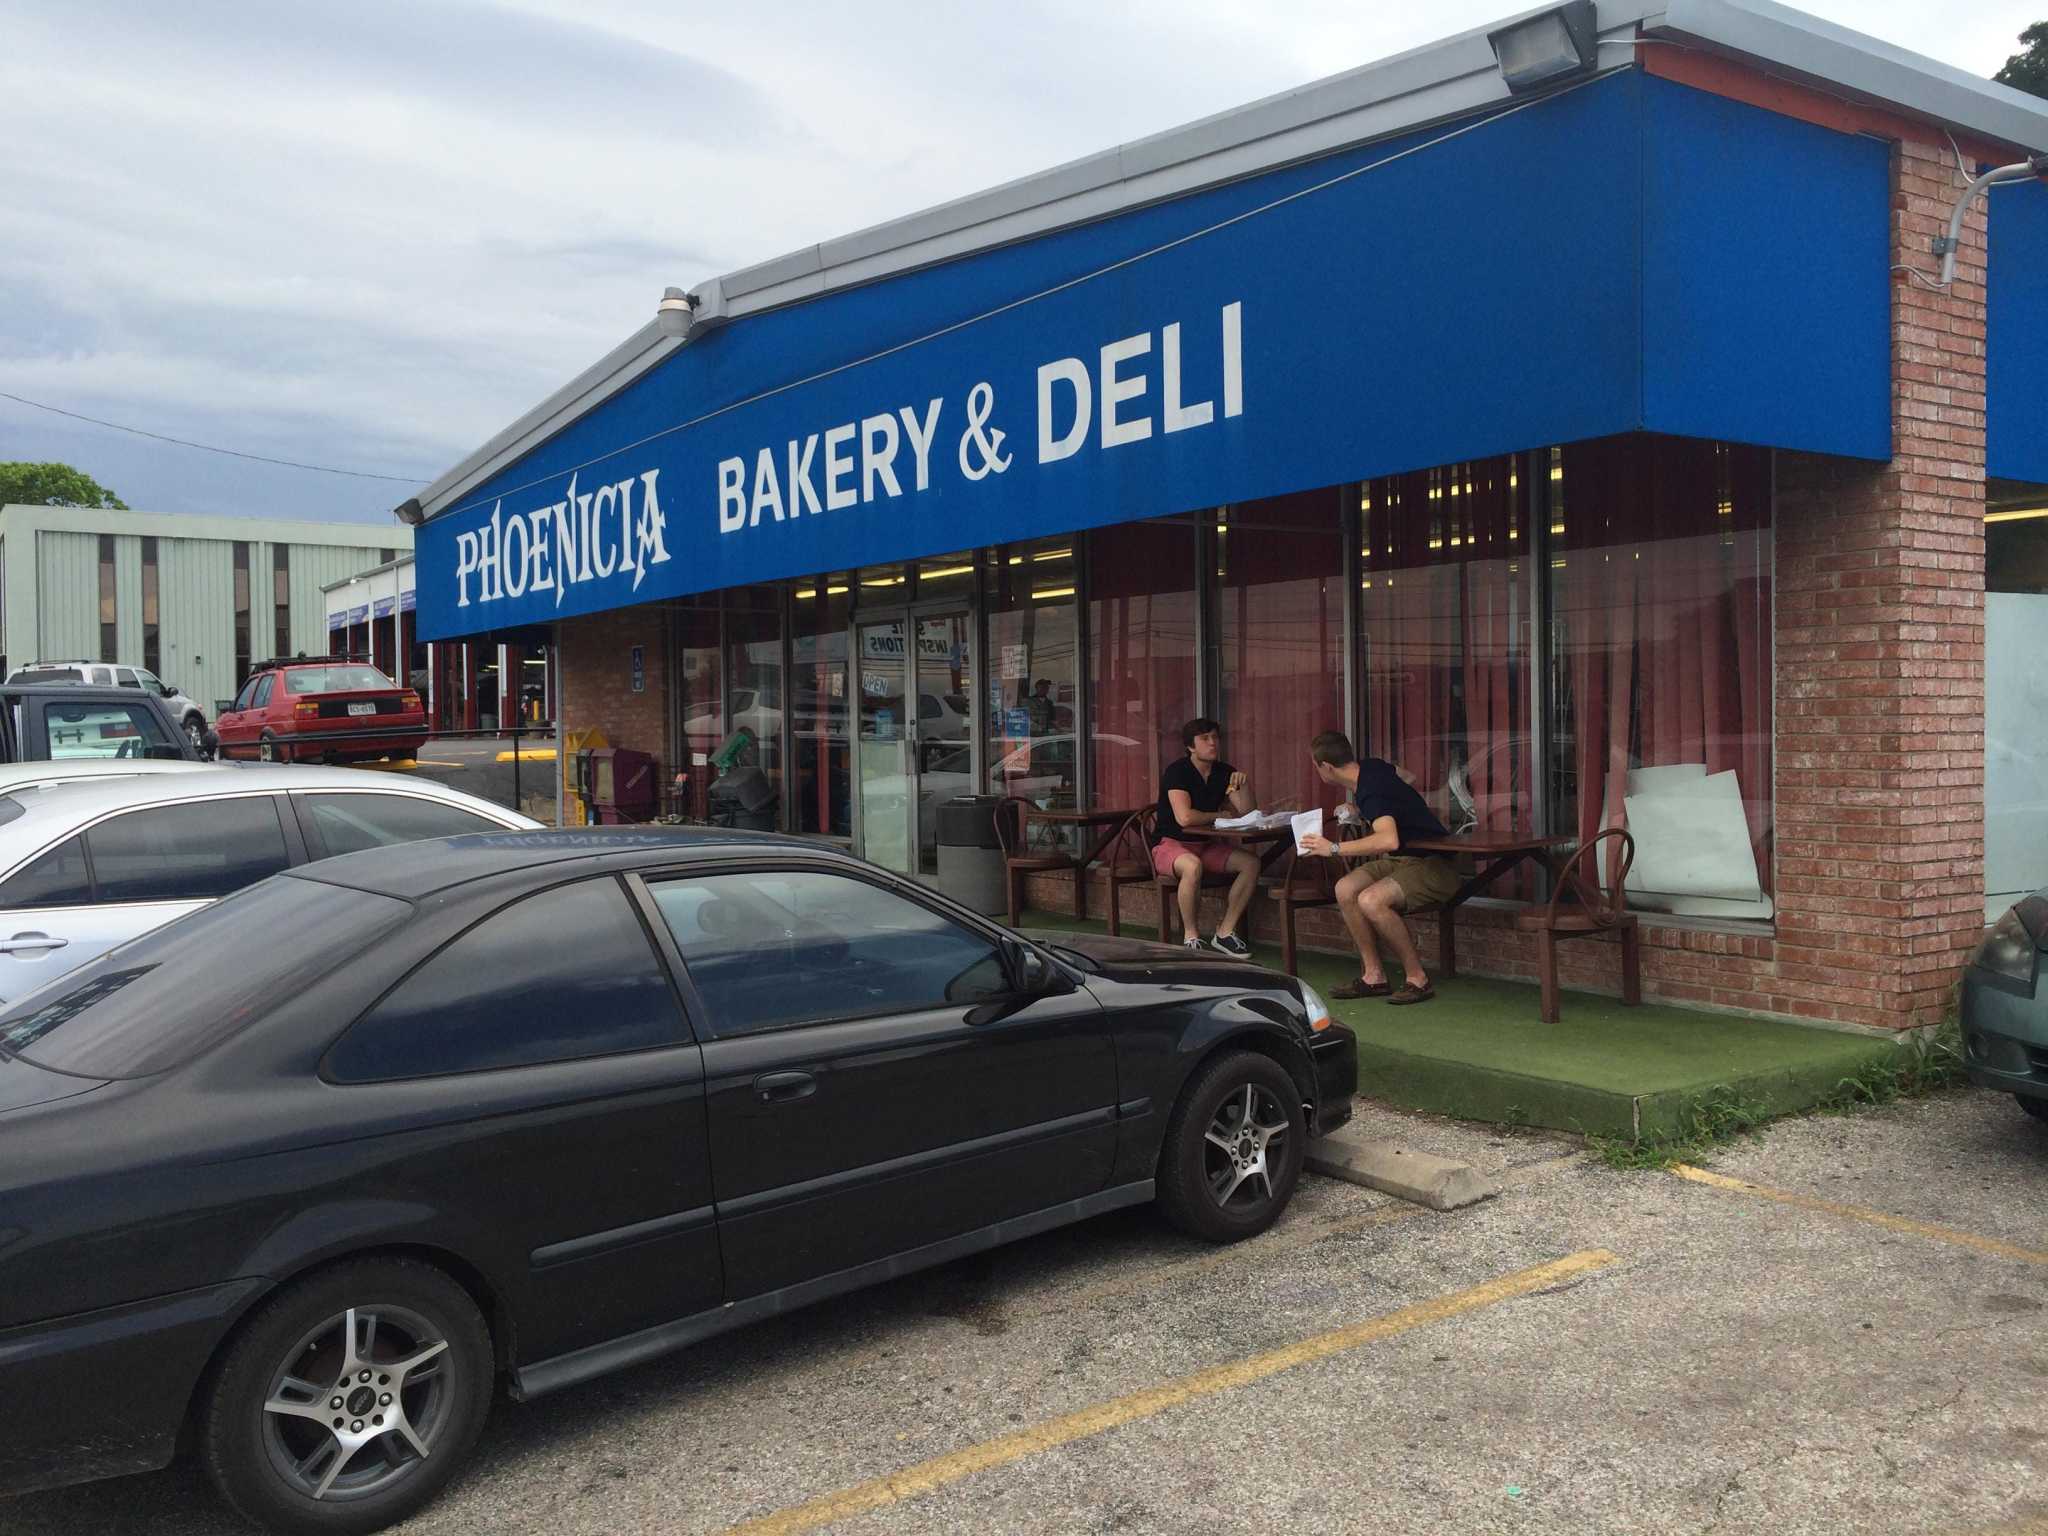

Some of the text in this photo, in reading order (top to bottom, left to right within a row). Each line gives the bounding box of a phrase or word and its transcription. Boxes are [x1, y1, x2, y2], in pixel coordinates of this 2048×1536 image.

[456, 300, 1243, 608] PHOENICIA BAKERY & DELI
